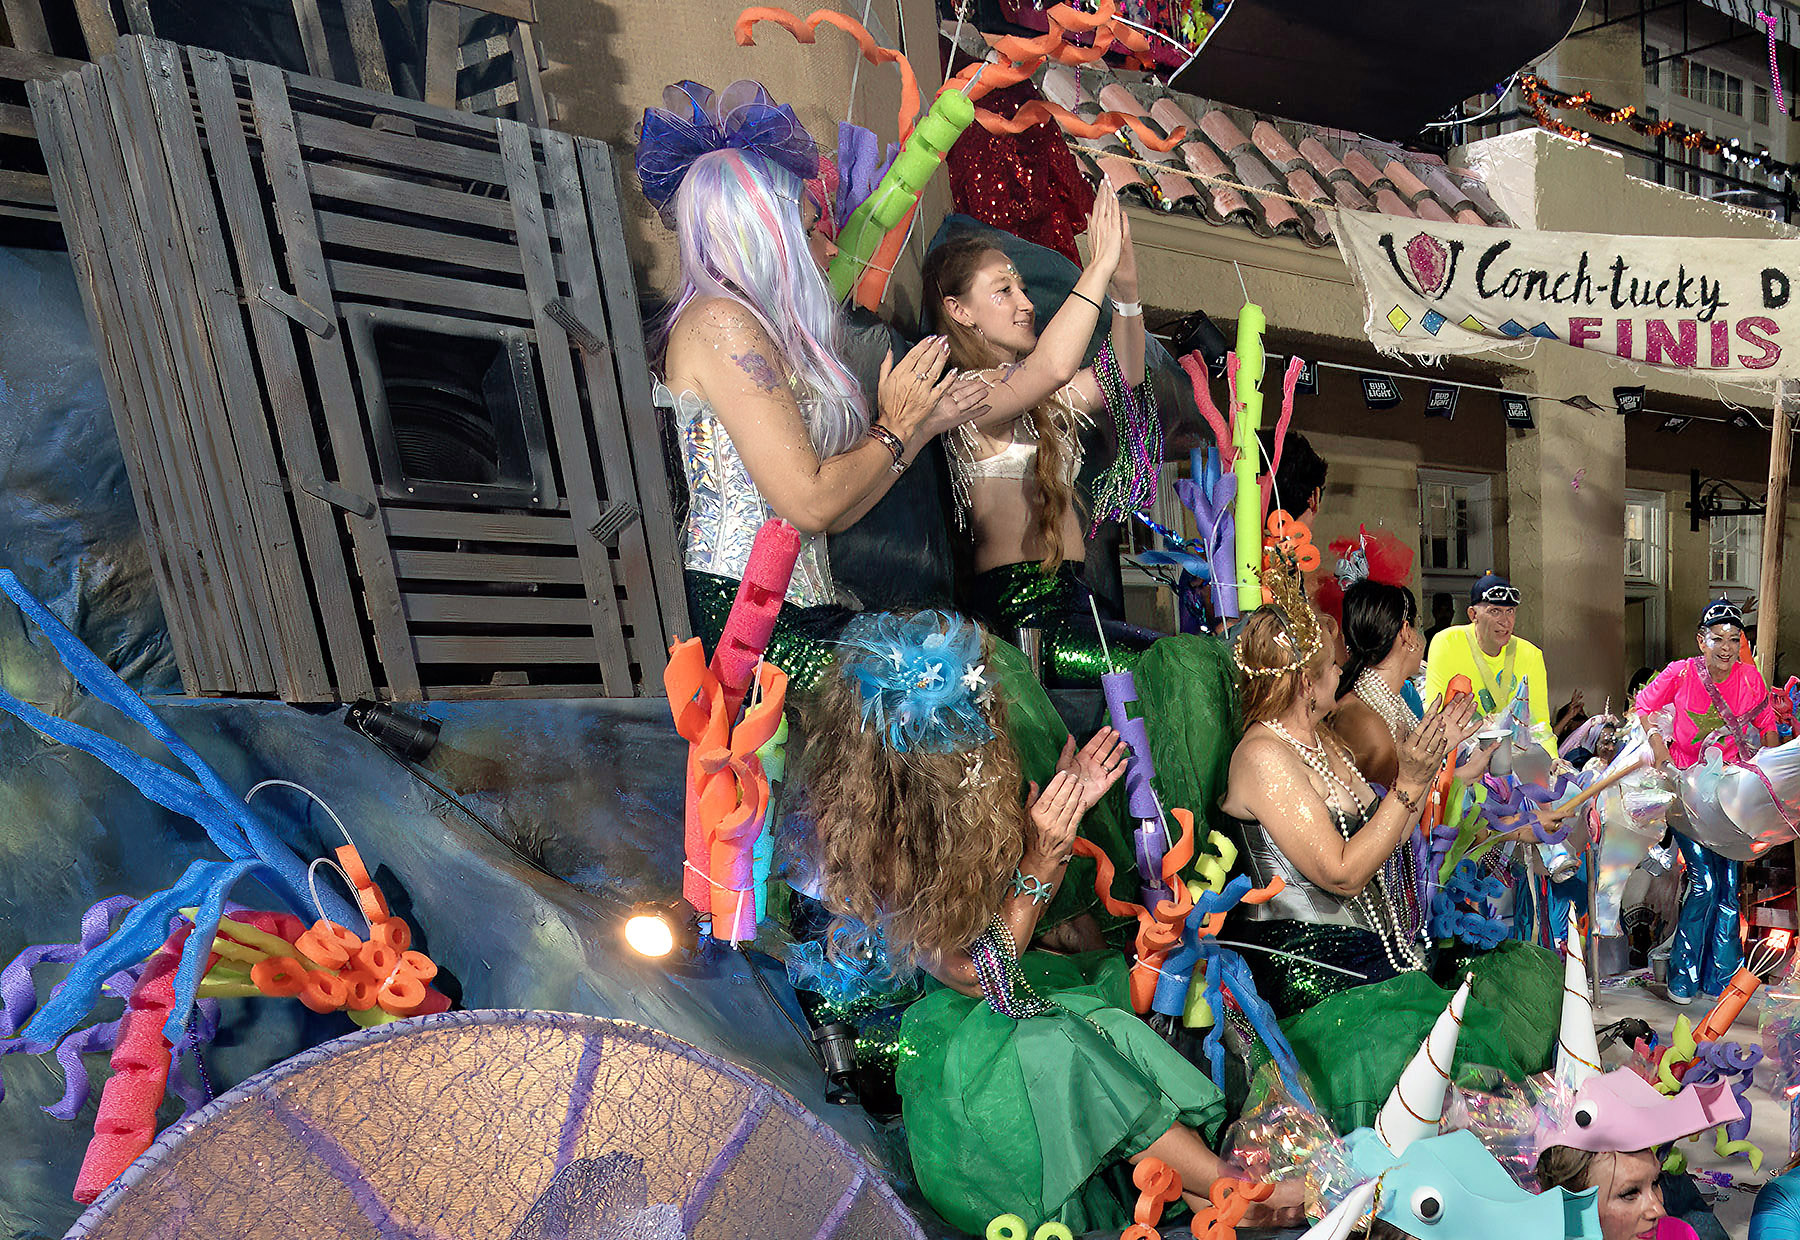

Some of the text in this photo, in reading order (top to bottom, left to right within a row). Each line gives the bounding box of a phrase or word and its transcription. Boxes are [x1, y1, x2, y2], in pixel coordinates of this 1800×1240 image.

[1475, 239, 1730, 323] Conch-tucky
[1368, 382, 1387, 390] BUD
[1368, 389, 1392, 398] LIGHT
